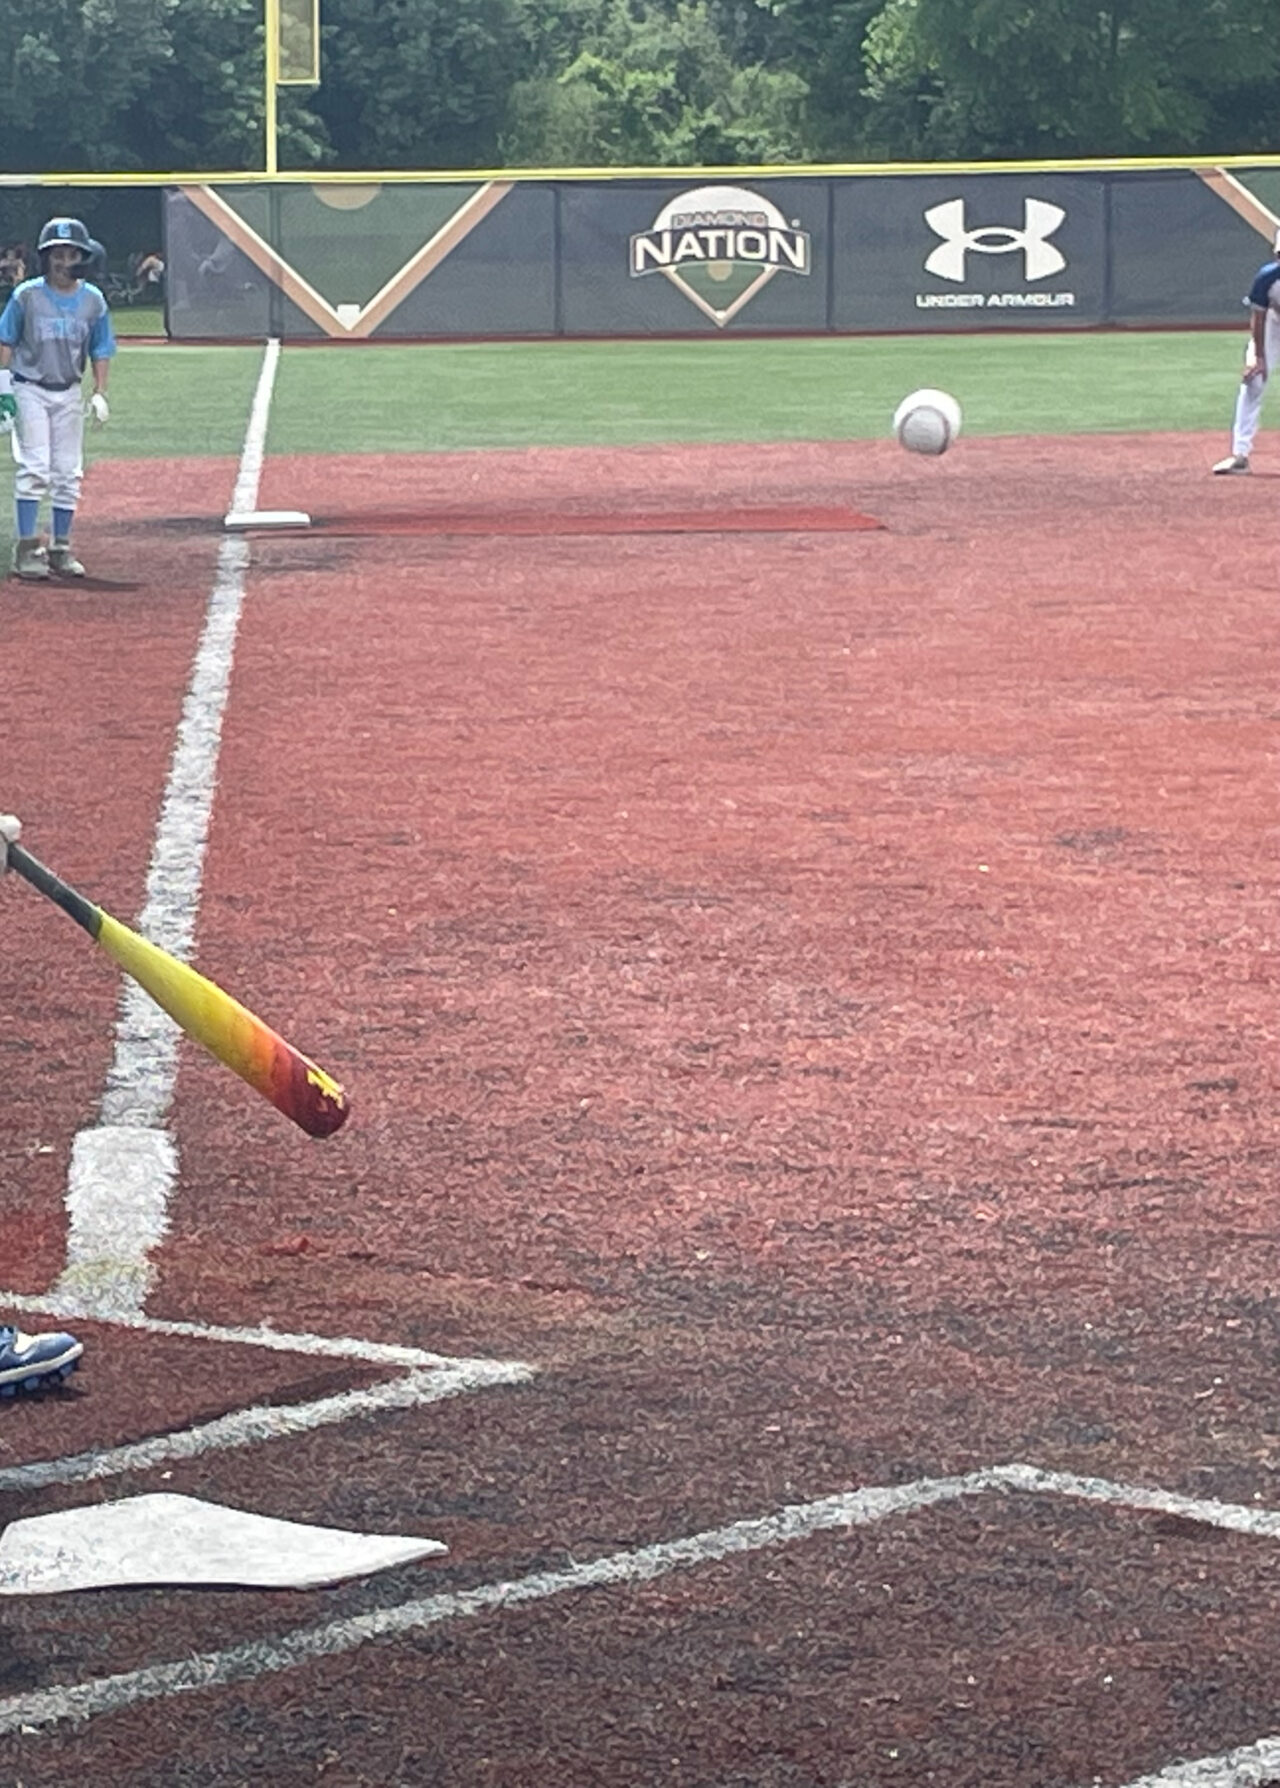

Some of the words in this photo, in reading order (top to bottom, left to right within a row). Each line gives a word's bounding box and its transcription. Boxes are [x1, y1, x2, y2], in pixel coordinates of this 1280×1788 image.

[672, 210, 768, 229] DIAMOND
[635, 229, 805, 271] NATION
[916, 293, 985, 308] UNDER
[986, 293, 1075, 307] ARMOUR
